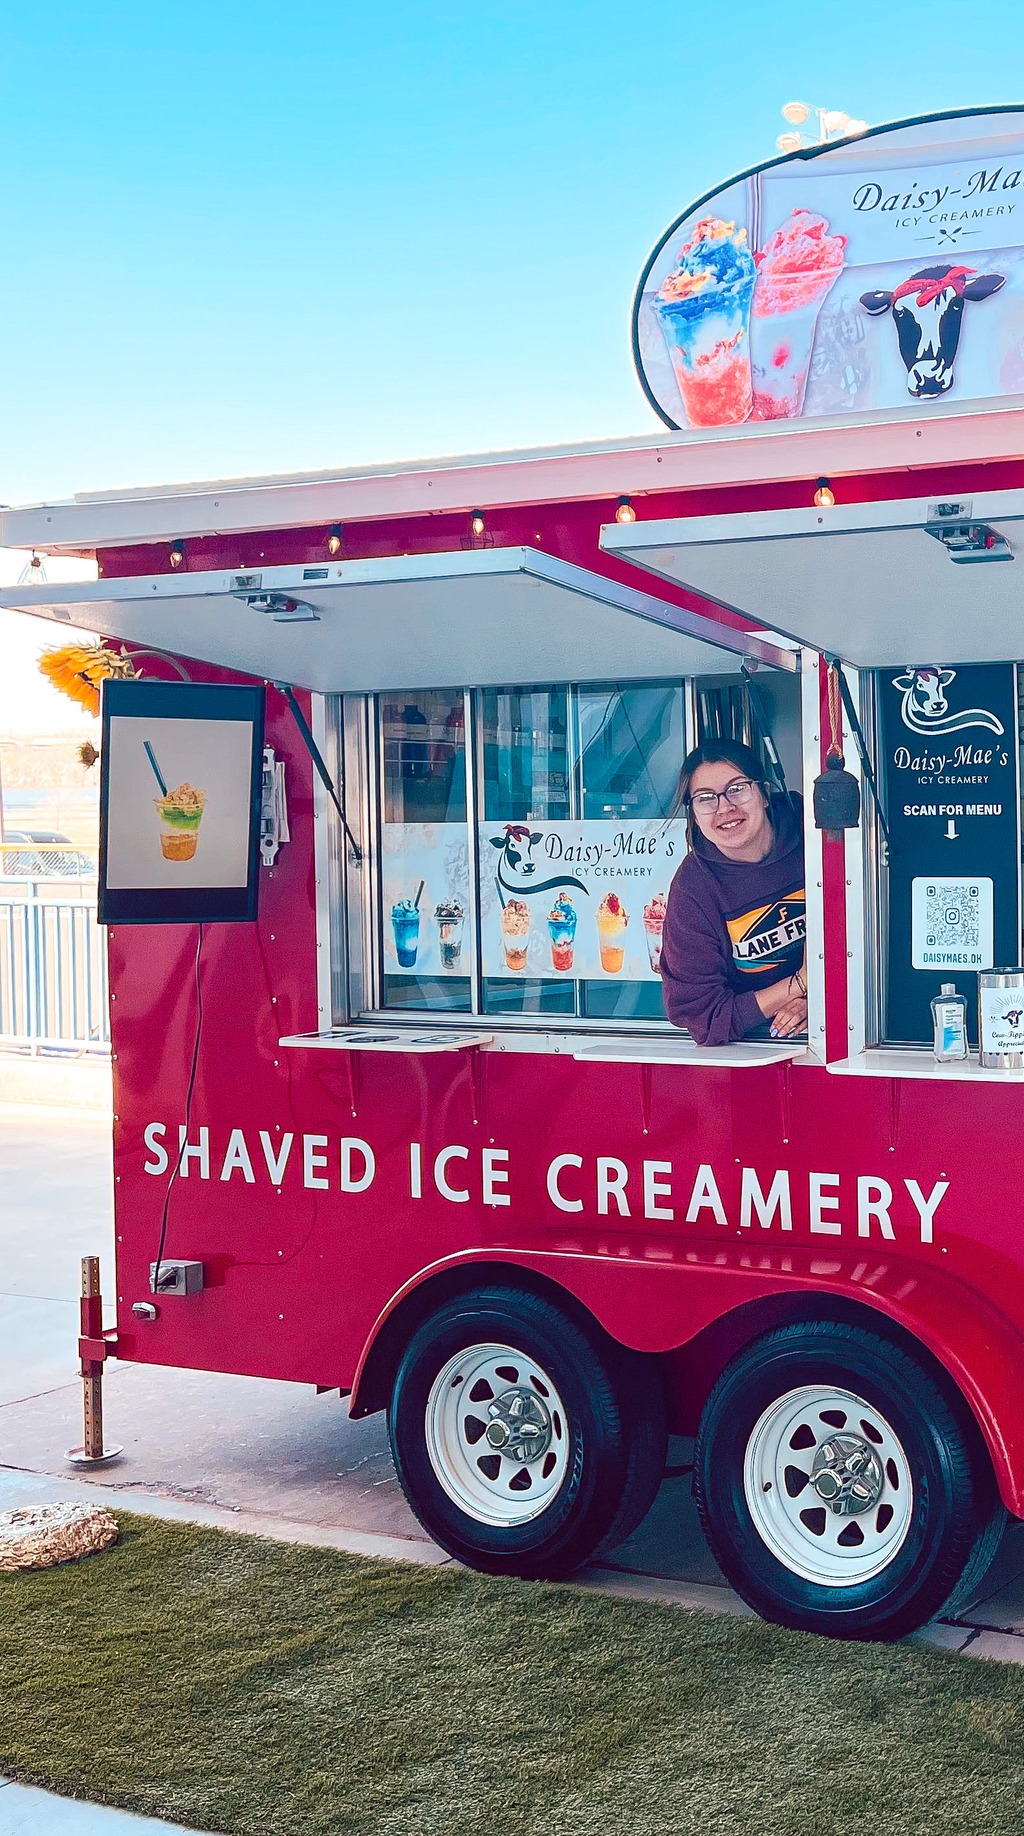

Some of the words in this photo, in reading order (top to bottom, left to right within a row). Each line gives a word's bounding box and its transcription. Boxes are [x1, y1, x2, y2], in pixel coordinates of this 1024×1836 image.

[895, 216, 923, 228] ICY
[929, 204, 1016, 225] CREAMERY
[894, 744, 1009, 775] Daisy-Mae's
[917, 776, 934, 784] ICY
[937, 775, 989, 784] CREAMERY
[903, 805, 937, 816] SCAN
[939, 805, 964, 816] FOR
[966, 804, 1002, 816] MENU
[545, 830, 676, 867] Daisy-Mae's
[571, 867, 590, 877] ICY
[594, 866, 653, 877] CREAMERY
[735, 931, 782, 958] LANE
[143, 1121, 375, 1194] SHAVED
[410, 1142, 510, 1207] ICE
[547, 1153, 951, 1244] CREAMERY
